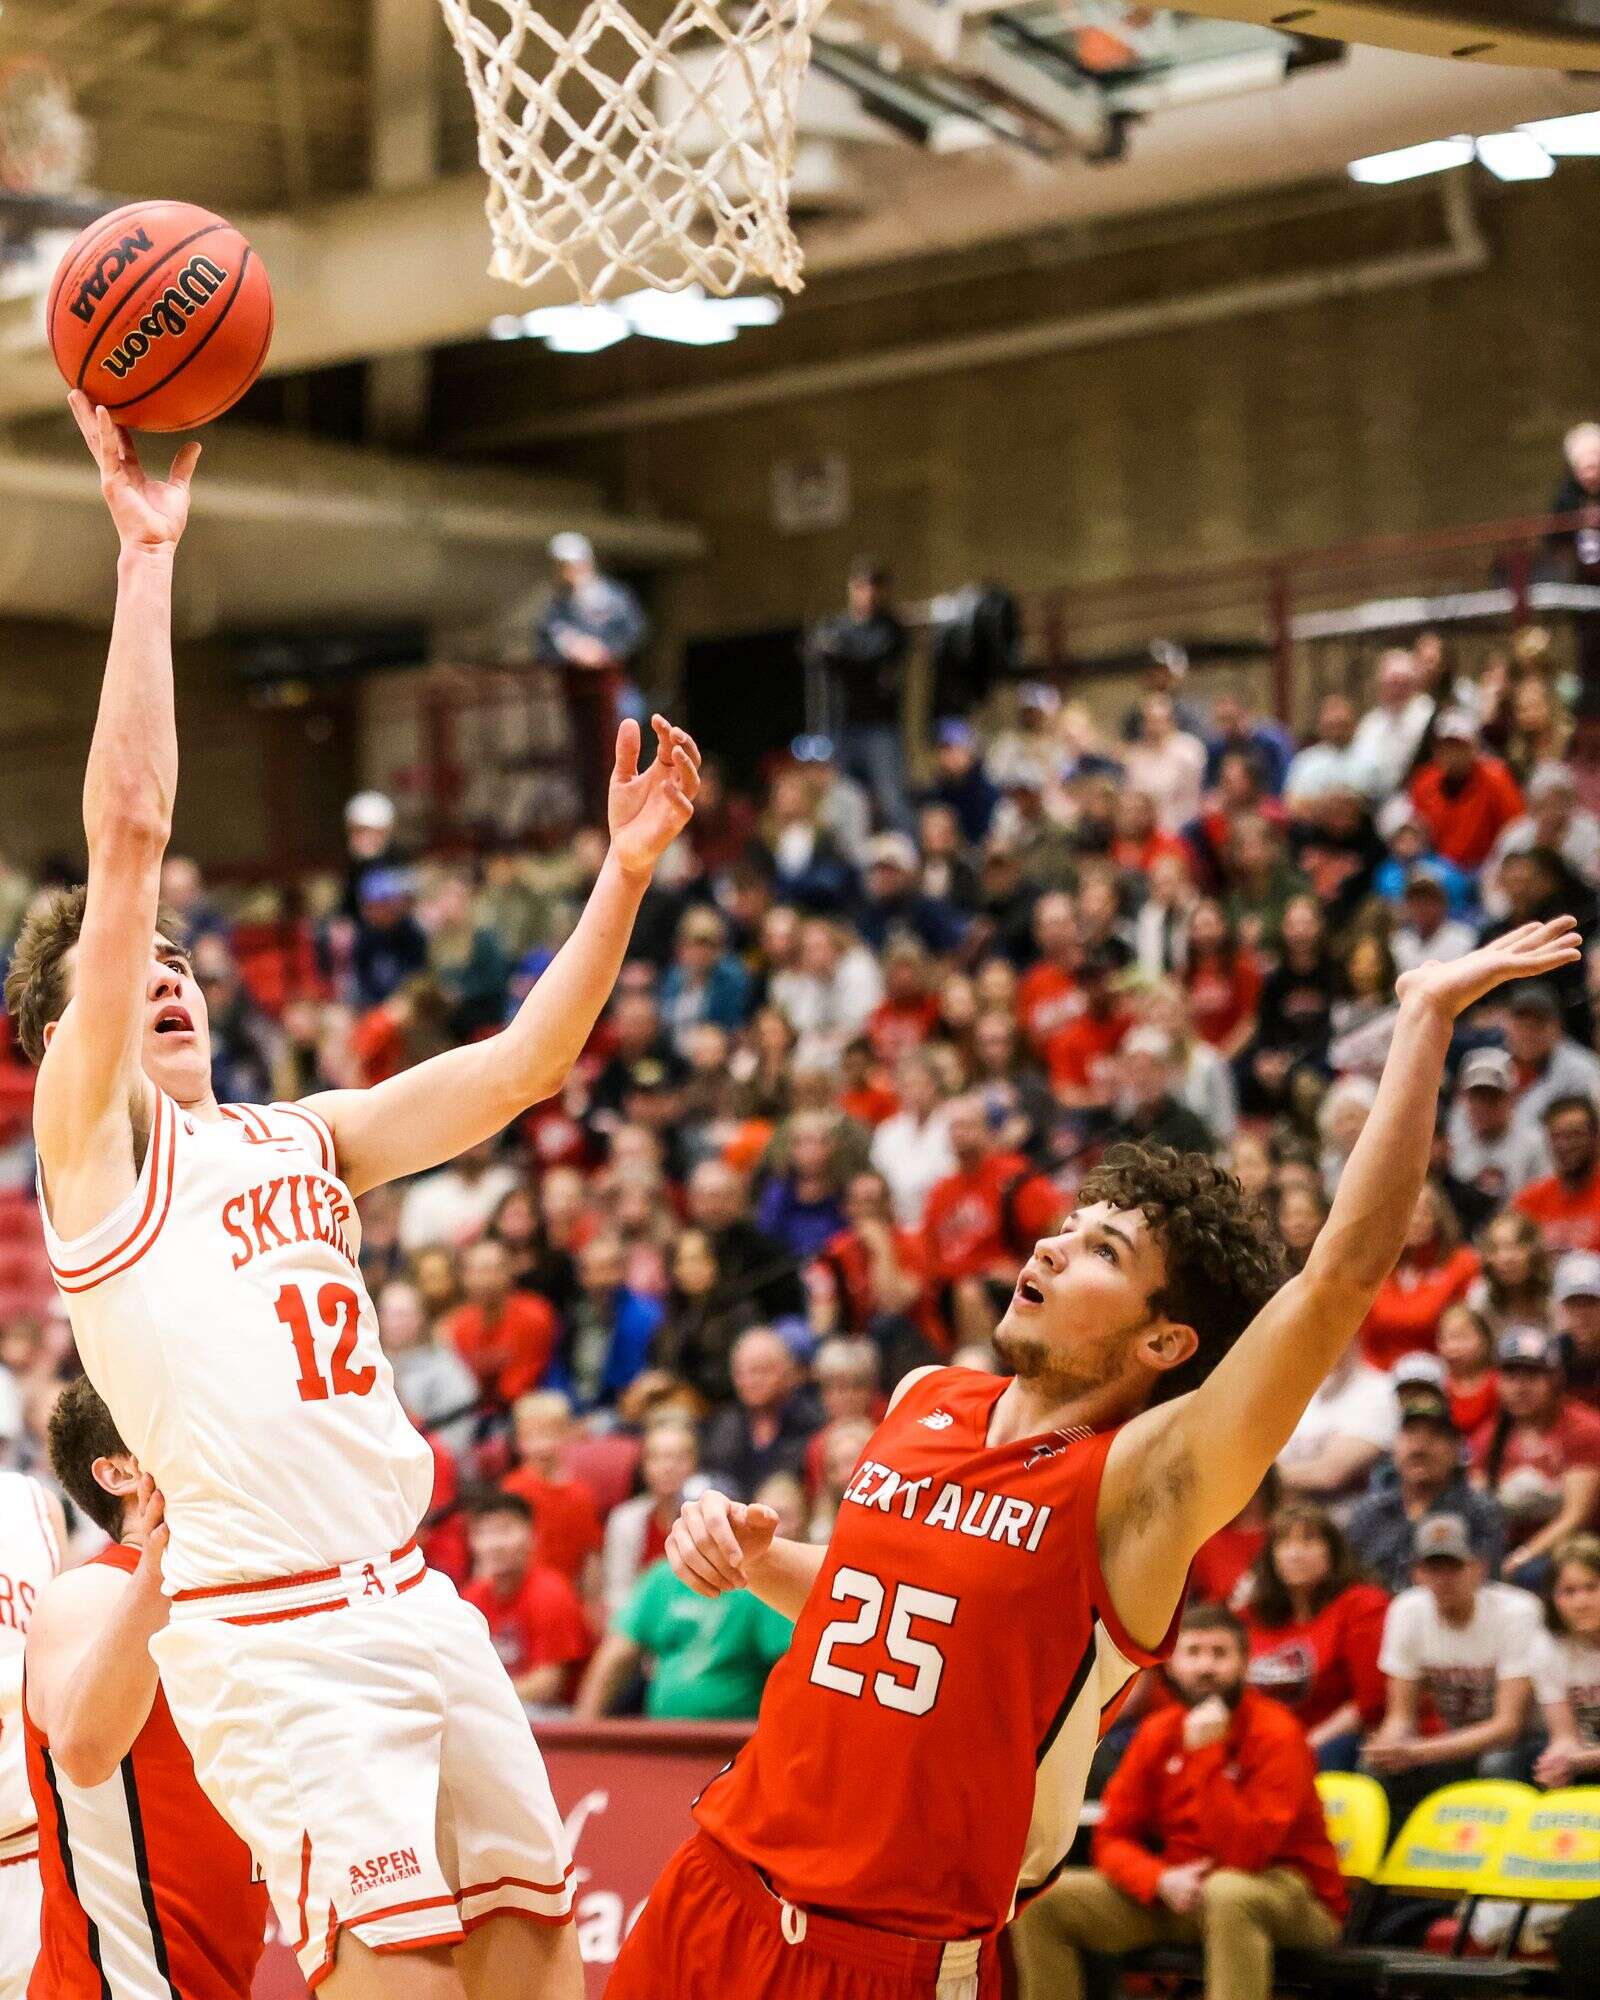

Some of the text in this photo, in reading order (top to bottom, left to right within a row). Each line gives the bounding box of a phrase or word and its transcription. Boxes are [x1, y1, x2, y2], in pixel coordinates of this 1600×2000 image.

[70, 226, 154, 325] NCAA
[101, 255, 230, 379] Wilson
[274, 1282, 376, 1401] 12
[842, 1460, 1052, 1552] CENTAURI
[361, 1562, 385, 1595] A
[809, 1566, 960, 1717] 25
[349, 1846, 418, 1884] ASPEN
